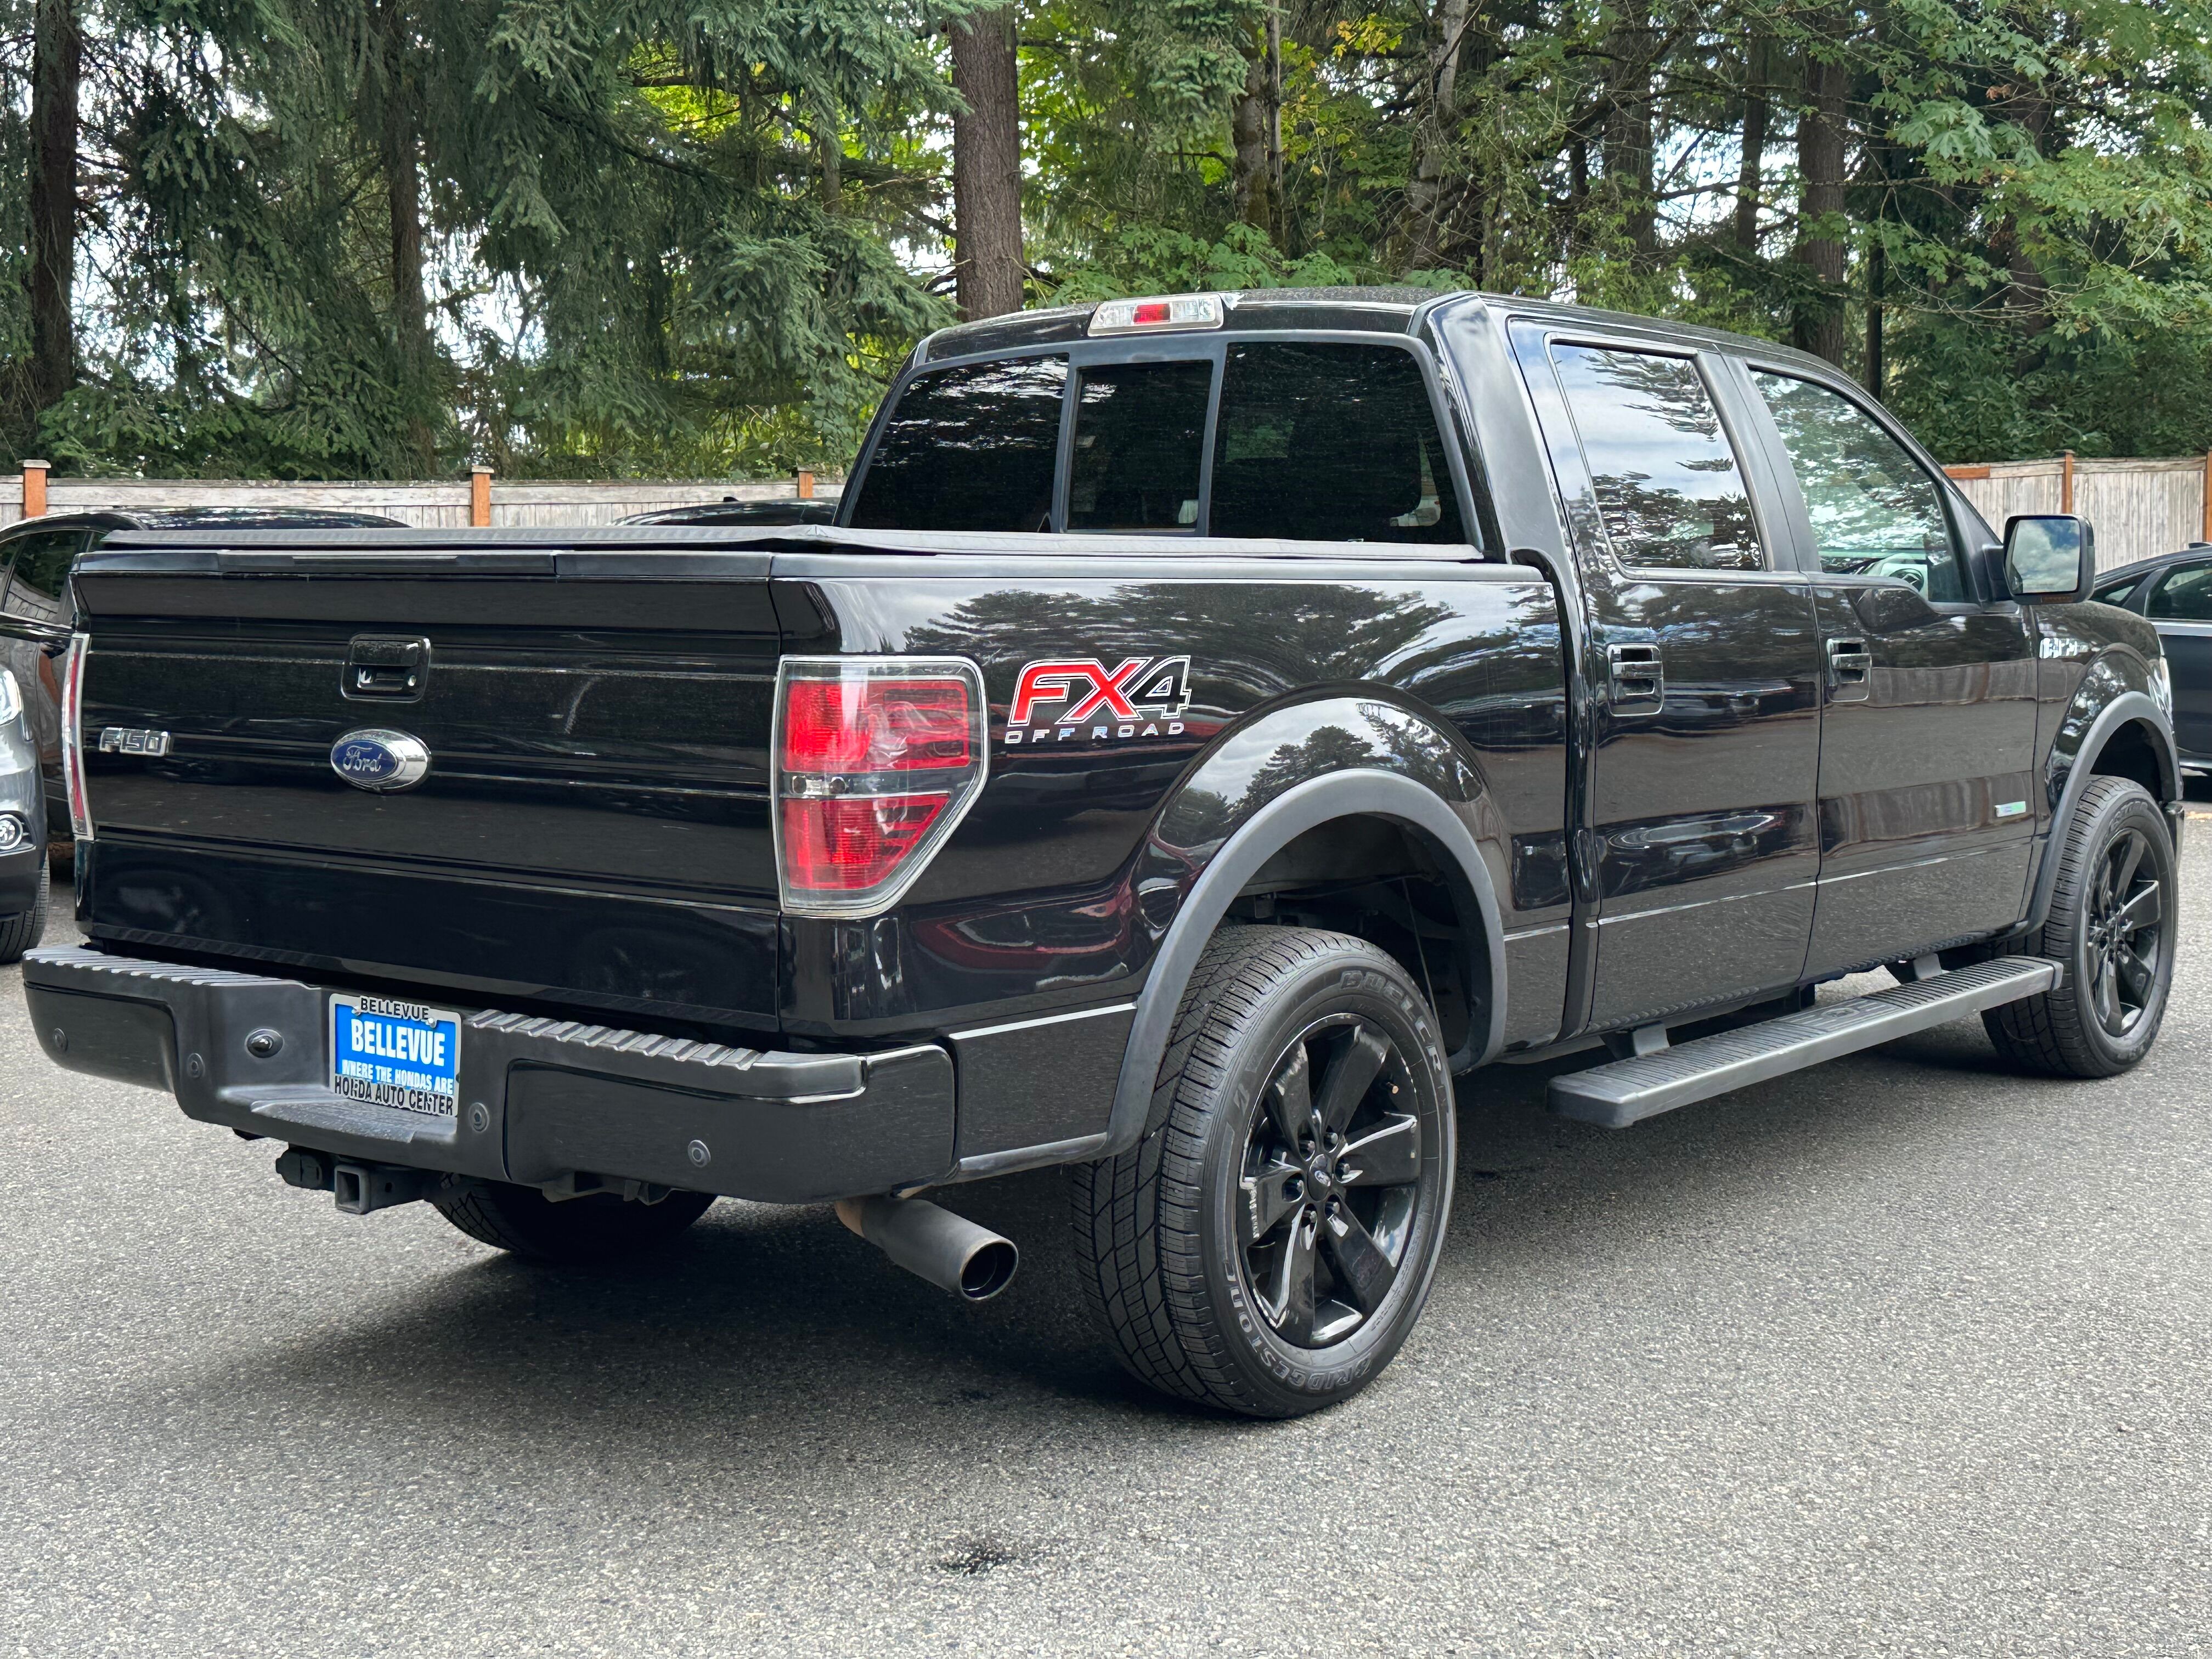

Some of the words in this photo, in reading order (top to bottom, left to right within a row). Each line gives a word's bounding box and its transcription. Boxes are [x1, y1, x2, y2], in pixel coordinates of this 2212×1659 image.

[1007, 655, 1192, 727] FX4
[1005, 727, 1075, 744] OFF
[1092, 722, 1184, 740] ROAD
[342, 745, 382, 772] Ford
[360, 997, 430, 1020] BELLEVUE
[351, 1018, 445, 1066] BELLEVUE
[341, 1059, 374, 1080] WHERE
[375, 1065, 392, 1084] THE
[394, 1069, 432, 1092] HONDAS
[433, 1076, 454, 1095] ARE
[334, 1075, 372, 1099] HONDA
[375, 1084, 405, 1106] AUTO
[409, 1089, 453, 1116] CENTER
